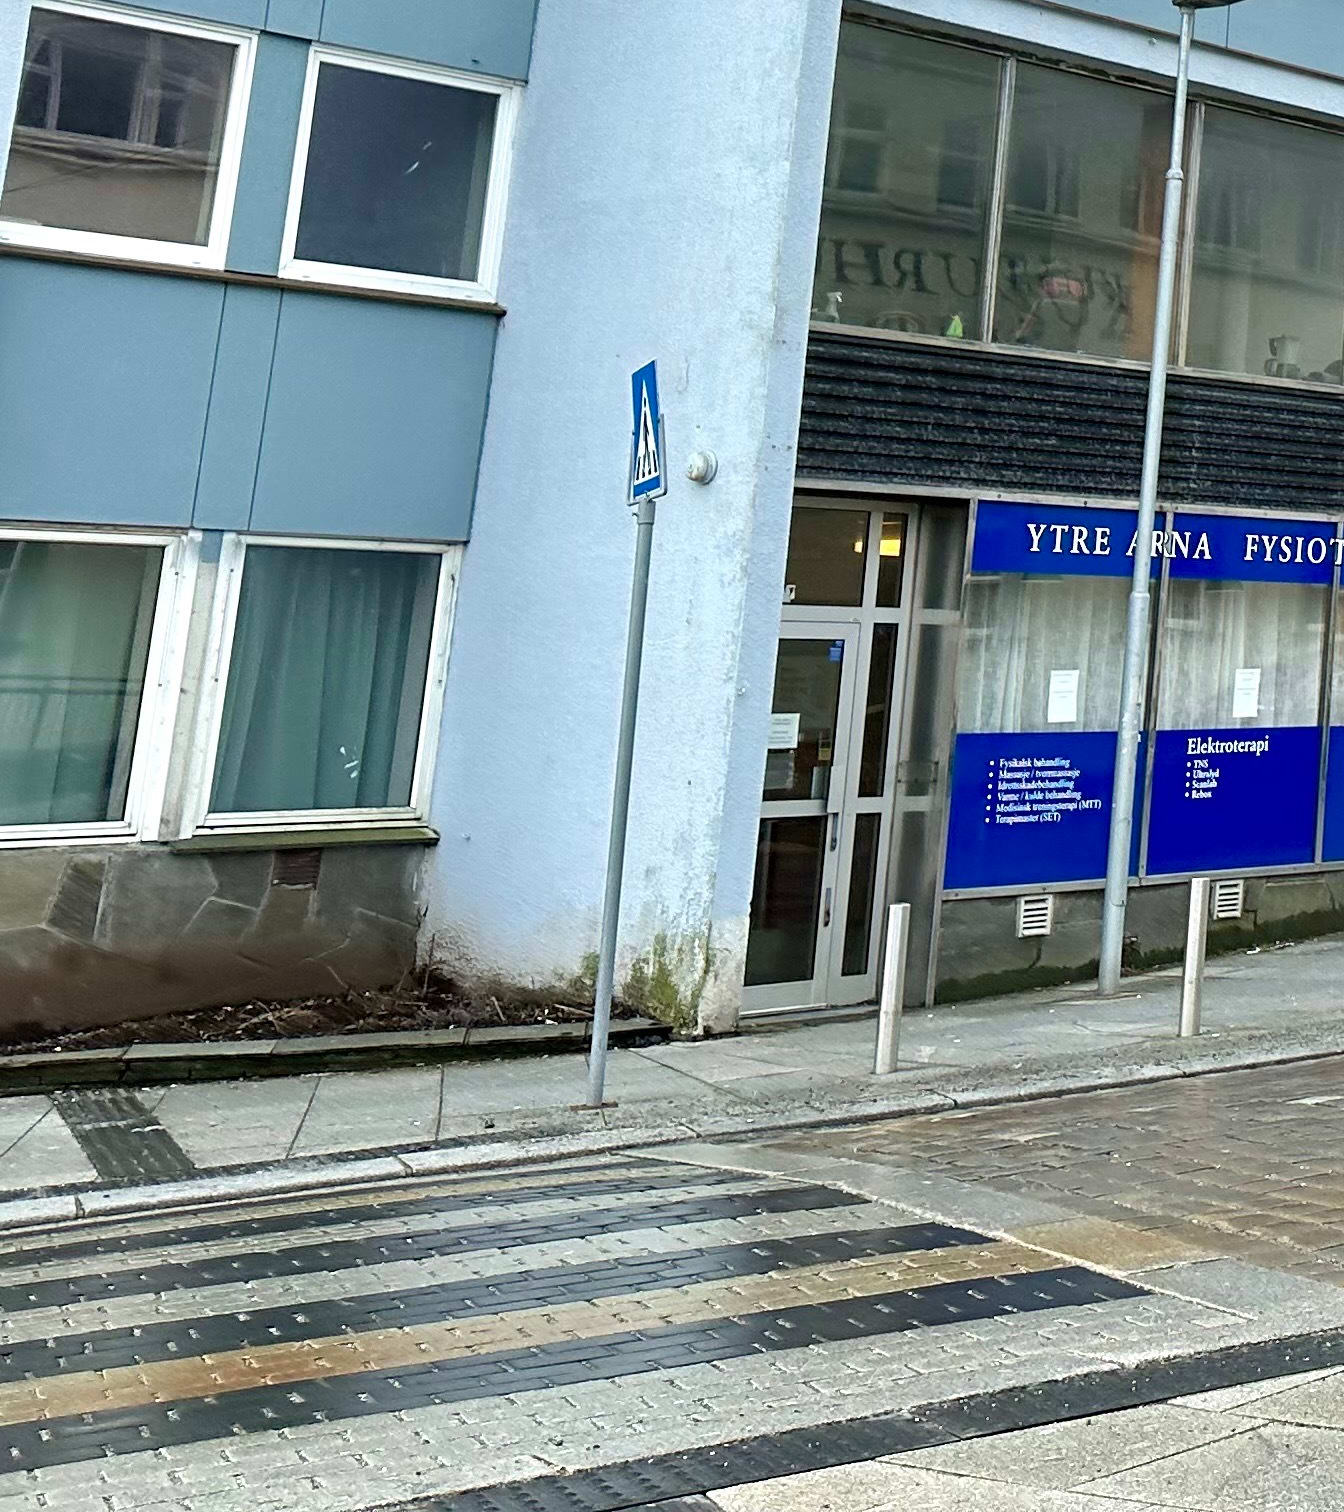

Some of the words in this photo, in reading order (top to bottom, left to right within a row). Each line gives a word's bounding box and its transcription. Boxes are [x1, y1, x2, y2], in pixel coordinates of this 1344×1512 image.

[1027, 523, 1111, 555] YTRE
[1187, 734, 1269, 756] Elektroterapi
[1193, 759, 1208, 769] TNS
[1078, 799, 1101, 810] (MTT)
